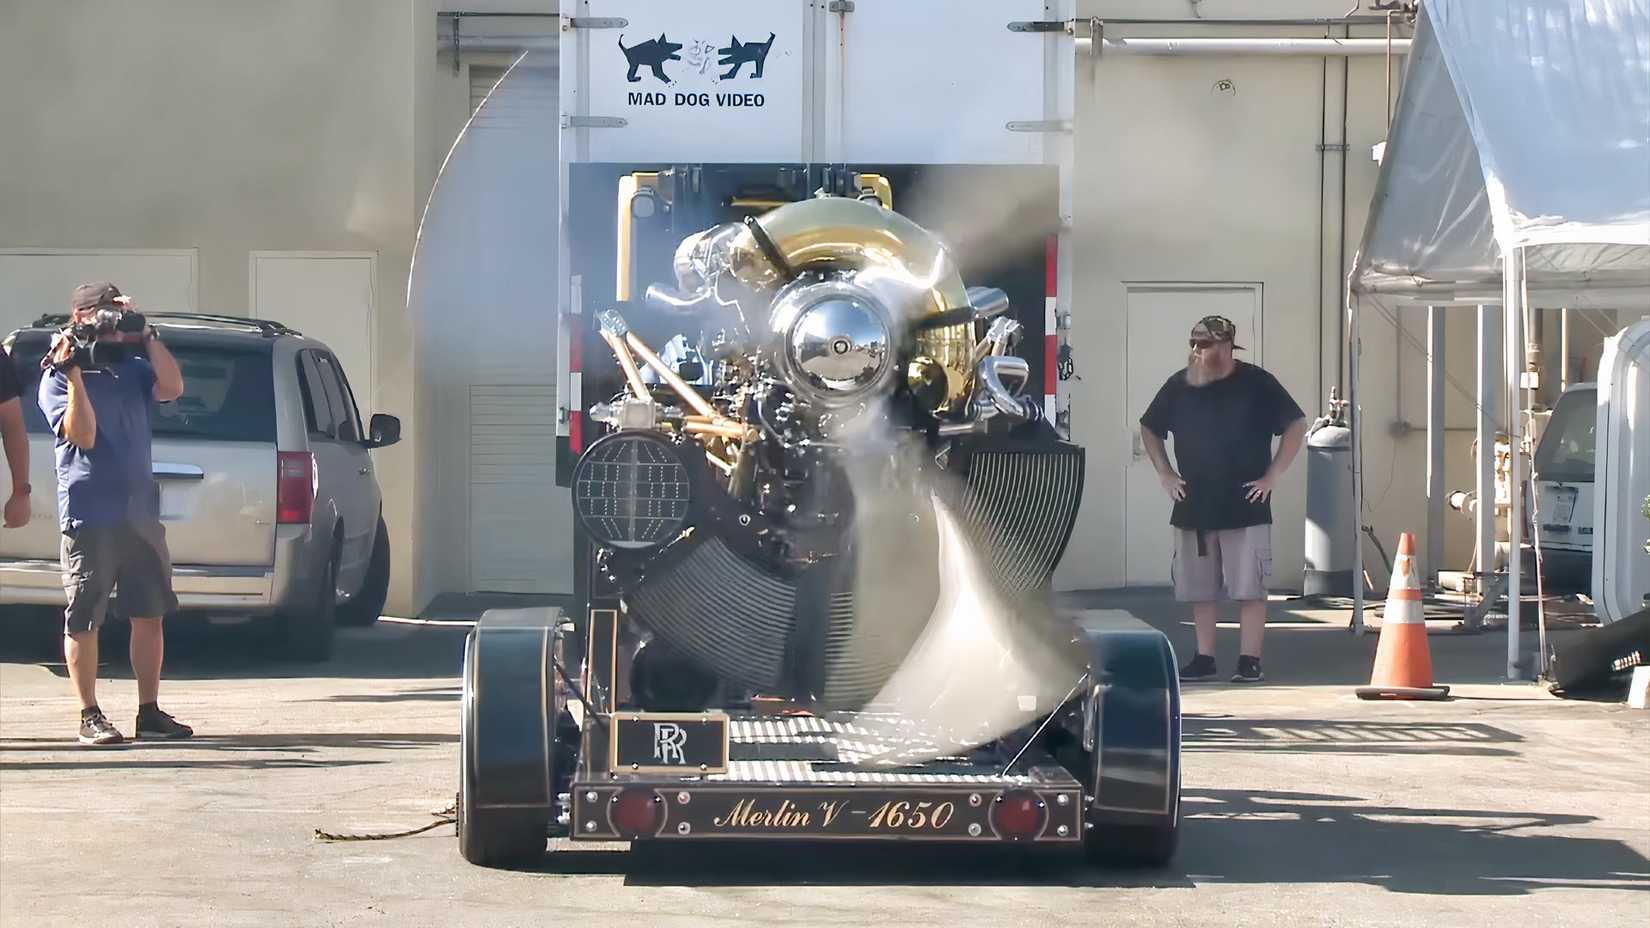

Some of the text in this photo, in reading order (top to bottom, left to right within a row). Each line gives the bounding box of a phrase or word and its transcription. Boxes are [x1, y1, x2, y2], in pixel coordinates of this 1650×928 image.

[628, 92, 765, 107] MAD DOG VIDEO
[713, 798, 811, 827] Merlin
